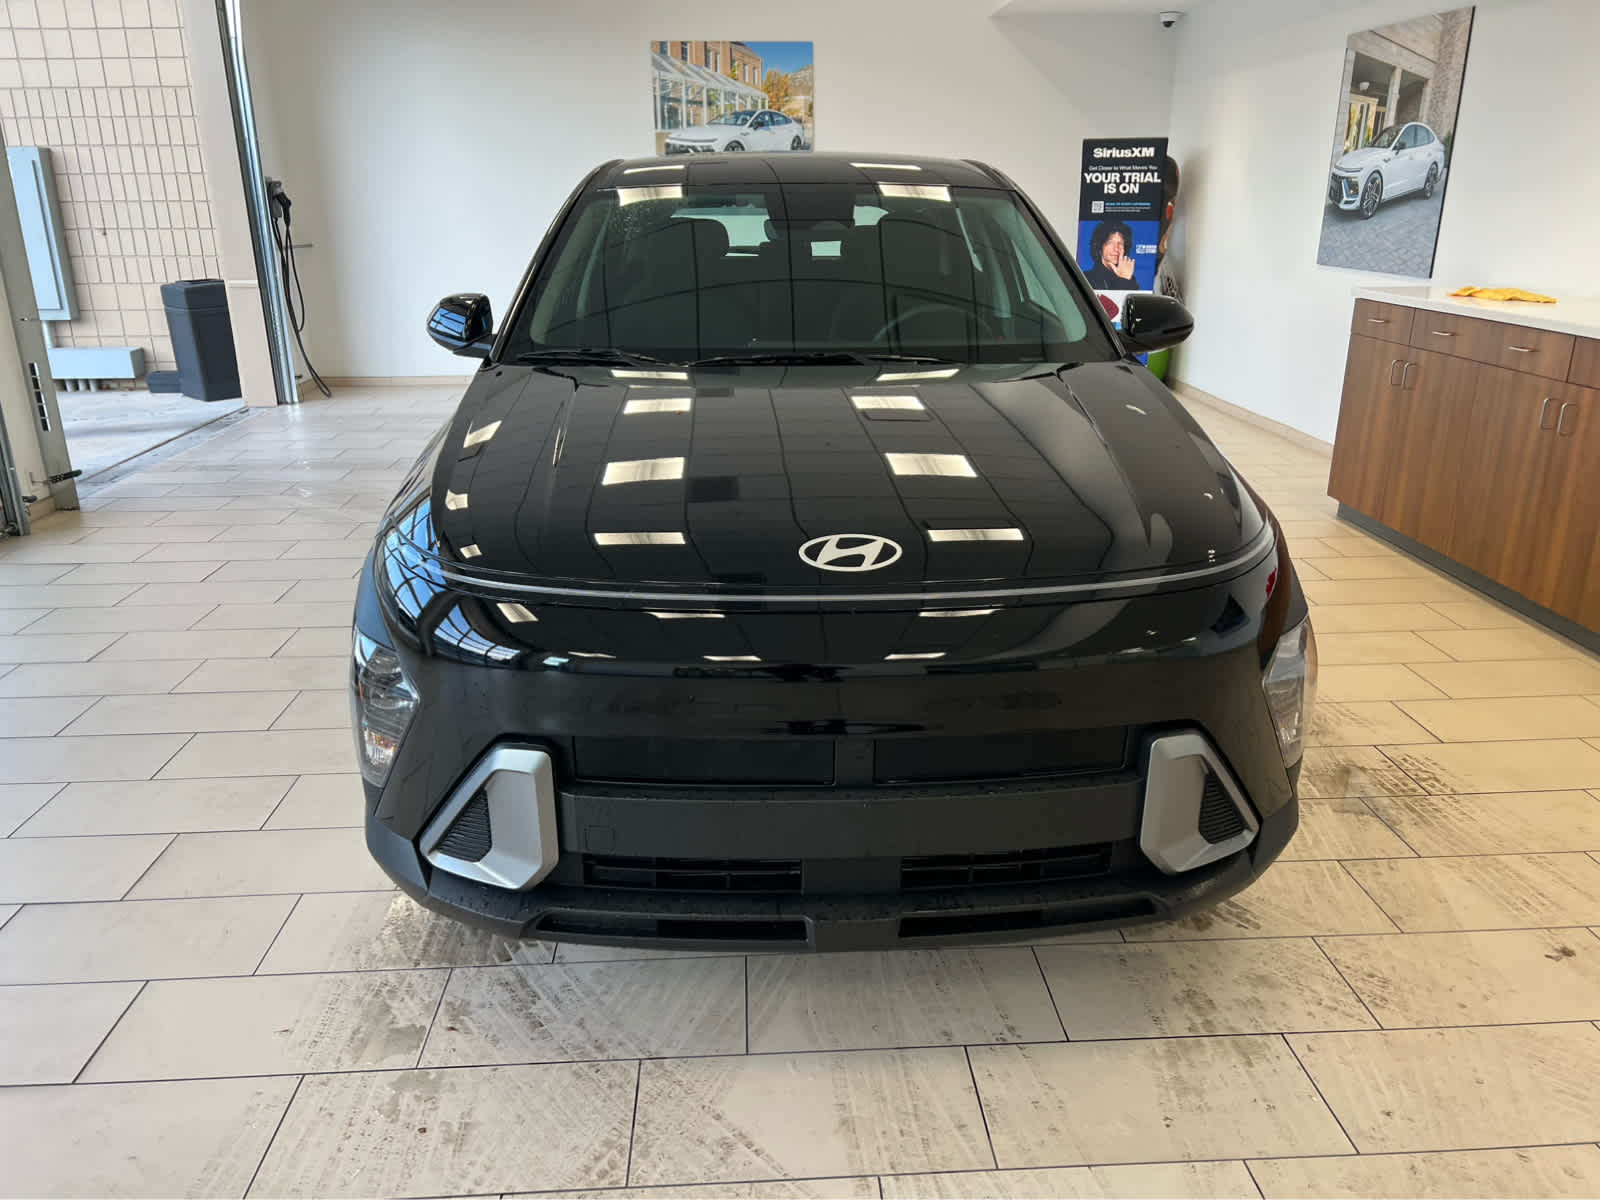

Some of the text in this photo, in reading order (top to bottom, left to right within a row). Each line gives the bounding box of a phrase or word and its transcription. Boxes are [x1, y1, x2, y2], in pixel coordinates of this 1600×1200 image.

[1093, 147, 1155, 158] SiriusXM
[1084, 171, 1161, 183] YOUR TRIAL
[1103, 183, 1139, 194] IS ON
